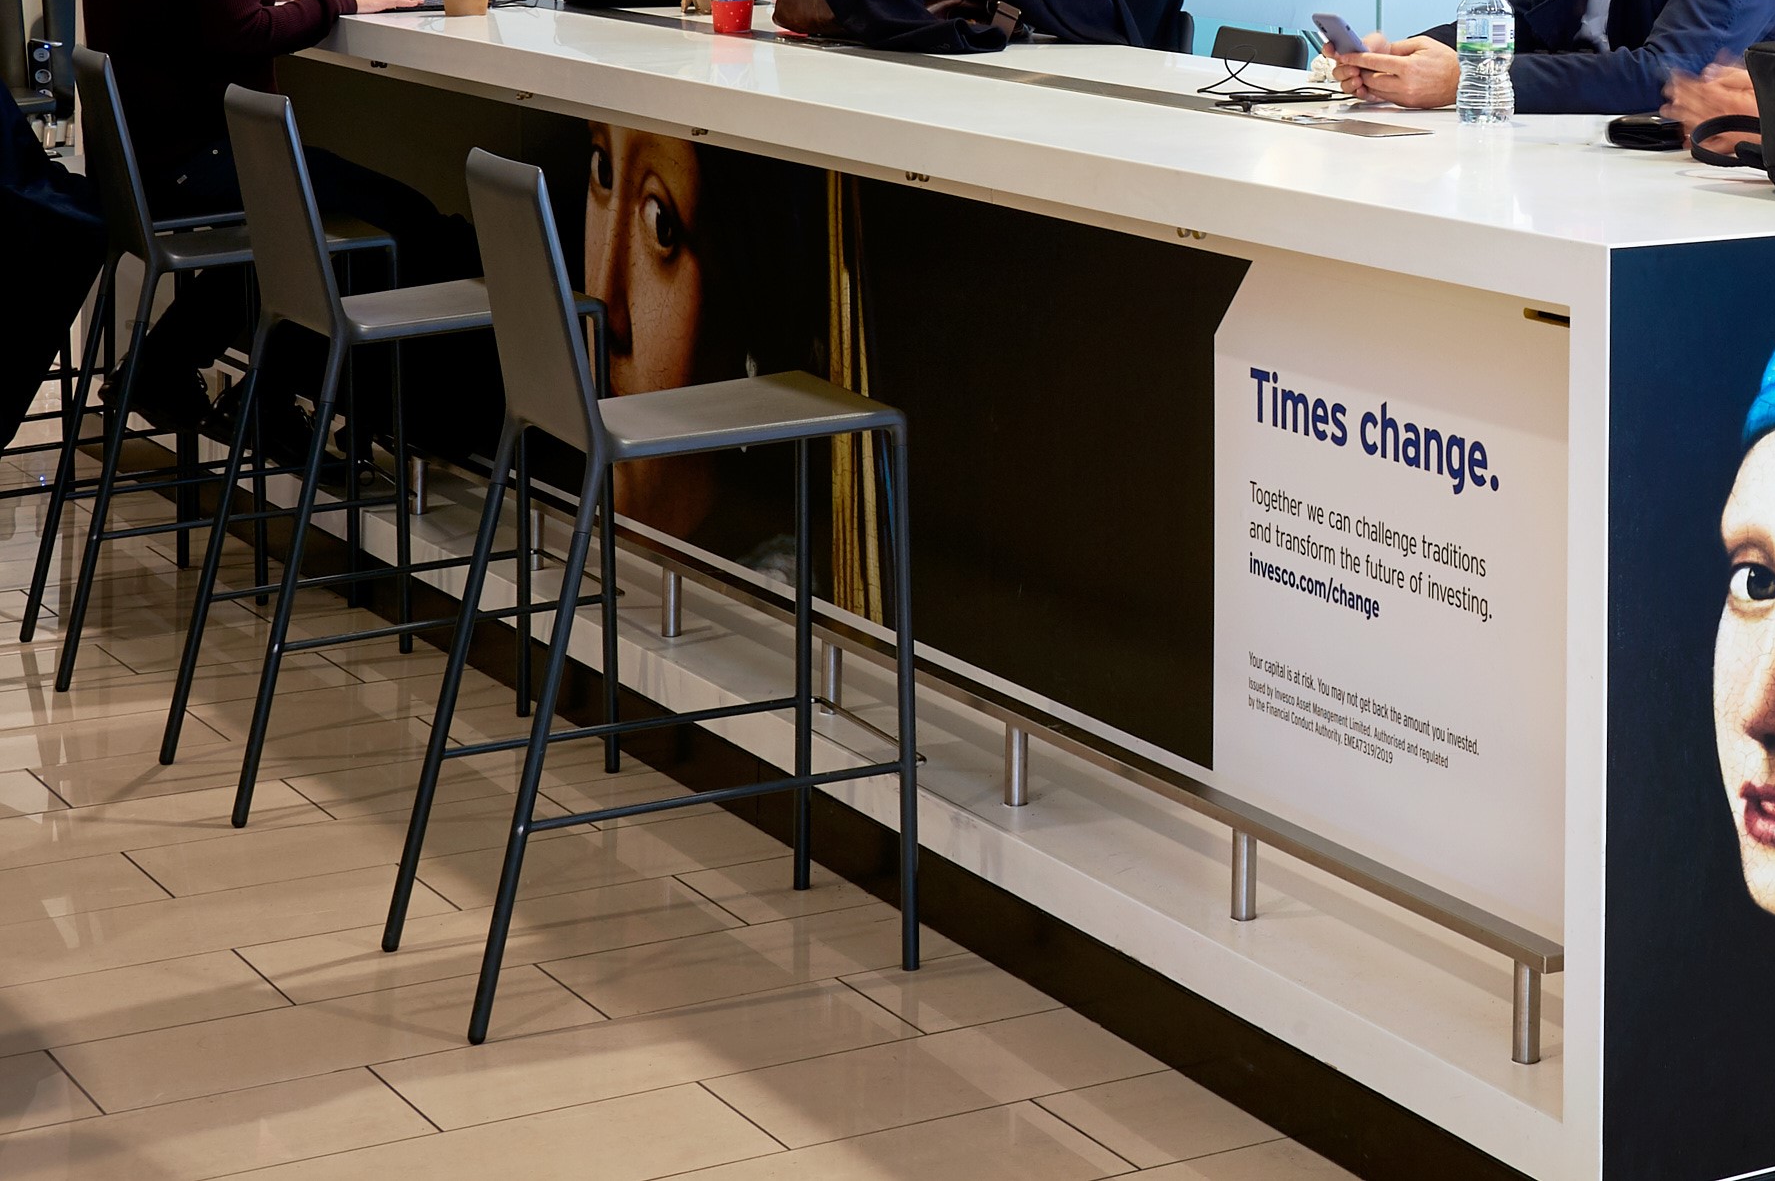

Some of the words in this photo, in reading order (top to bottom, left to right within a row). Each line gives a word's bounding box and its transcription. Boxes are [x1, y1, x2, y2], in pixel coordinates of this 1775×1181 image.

[1250, 366, 1348, 447] Times
[1359, 401, 1499, 495] change.
[1249, 480, 1303, 518] Together
[1306, 503, 1324, 525] we
[1328, 510, 1351, 534] can
[1355, 515, 1417, 558] challenge
[1421, 534, 1486, 578] traditions
[1249, 521, 1272, 544] and
[1275, 524, 1336, 566] transform
[1340, 546, 1361, 574] the
[1365, 553, 1405, 589] future
[1409, 571, 1423, 595] of
[1428, 574, 1492, 623] investing.
[1249, 551, 1380, 621] invesco.com/change
[1248, 651, 1264, 670] Your
[1264, 660, 1286, 679] capital
[1286, 665, 1293, 682] is
[1293, 669, 1301, 686] at
[1301, 672, 1316, 691] risk.
[1317, 677, 1330, 697] You
[1331, 686, 1346, 706] may
[1346, 692, 1359, 708] not
[1359, 697, 1371, 714] get
[1372, 699, 1389, 720] back
[1389, 705, 1402, 725] the
[1403, 714, 1431, 737] amount
[1431, 725, 1446, 742] you
[1446, 727, 1480, 756] invested.
[1248, 676, 1266, 695] Issued
[1266, 684, 1274, 700] by
[1275, 687, 1296, 703] Invesco
[1296, 696, 1312, 712] Asset
[1312, 702, 1348, 728] Management
[1349, 716, 1373, 738] Limited.
[1373, 727, 1406, 752] Authorised
[1406, 742, 1419, 757] and
[1419, 747, 1449, 769] regulated
[1248, 694, 1256, 710] by
[1256, 697, 1266, 712] the
[1266, 701, 1290, 722] Financial
[1290, 711, 1314, 733] Conduct
[1314, 721, 1343, 746] Authority.
[1343, 732, 1394, 765] EMEA7319/2019
